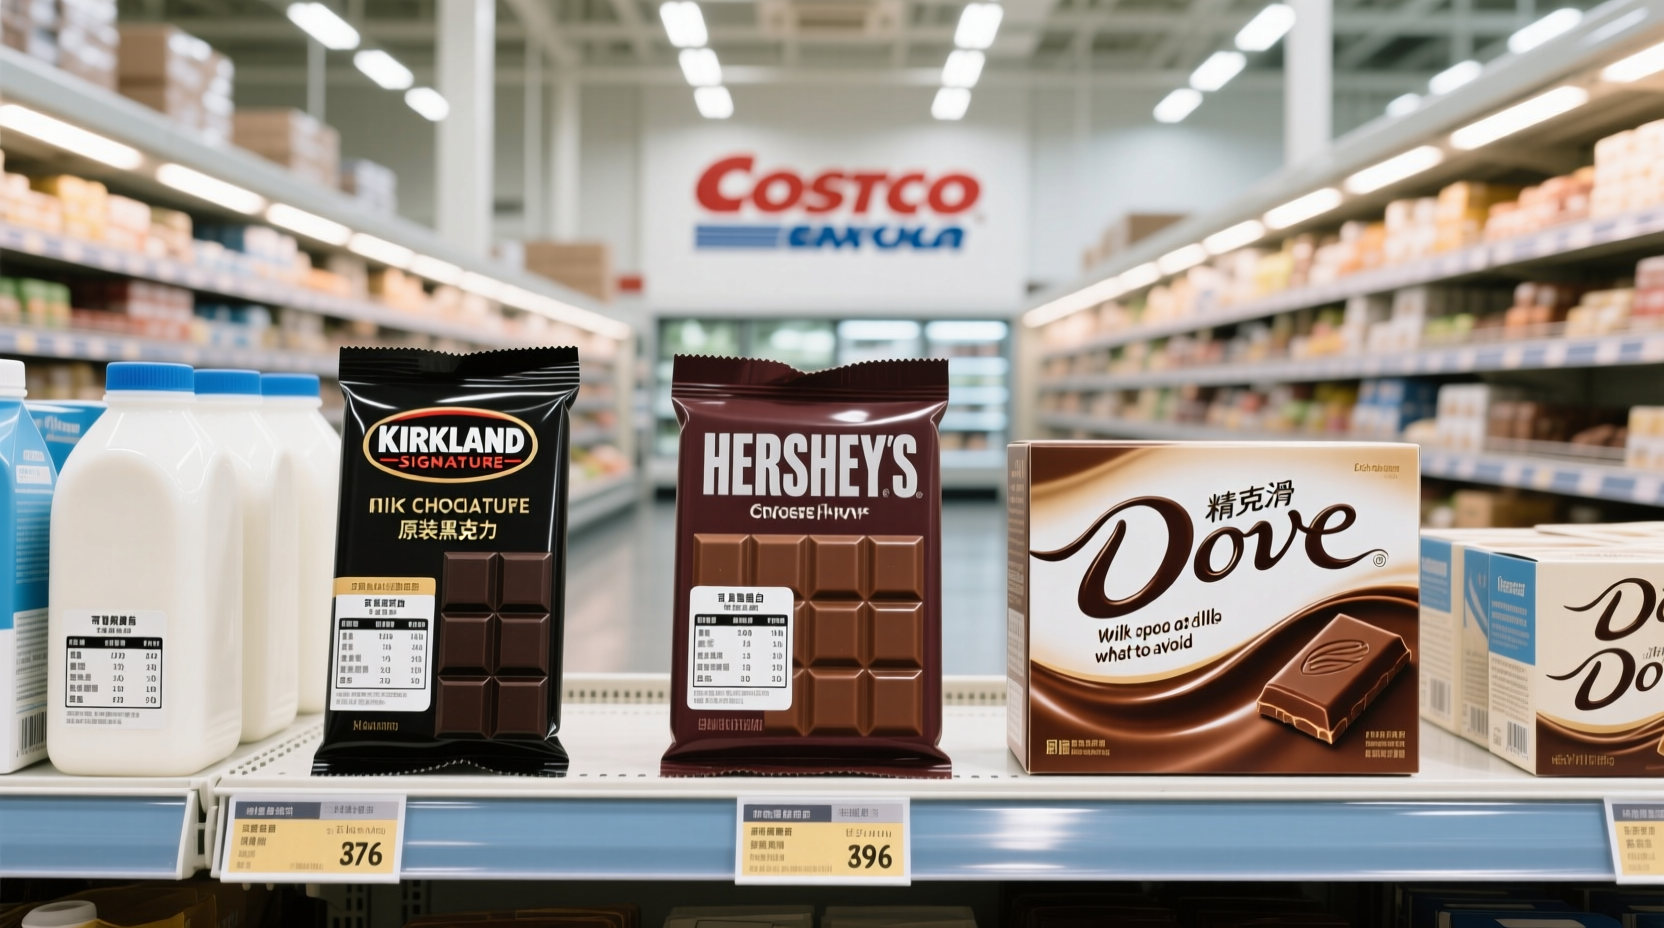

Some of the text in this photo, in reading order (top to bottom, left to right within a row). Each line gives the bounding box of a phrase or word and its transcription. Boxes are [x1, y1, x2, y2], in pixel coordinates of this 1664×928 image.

[694, 154, 981, 215] COSTCO
[377, 425, 525, 454] KIRKLAND
[399, 455, 504, 469] SIGNATURE
[703, 432, 918, 498] HERSHEY'S
[1205, 479, 1294, 523] 精克滑
[398, 519, 497, 541] 原装黑克力
[1030, 495, 1390, 618] Dove
[1153, 633, 1193, 655] avoid
[339, 841, 383, 866] 376
[848, 844, 893, 869] 396
